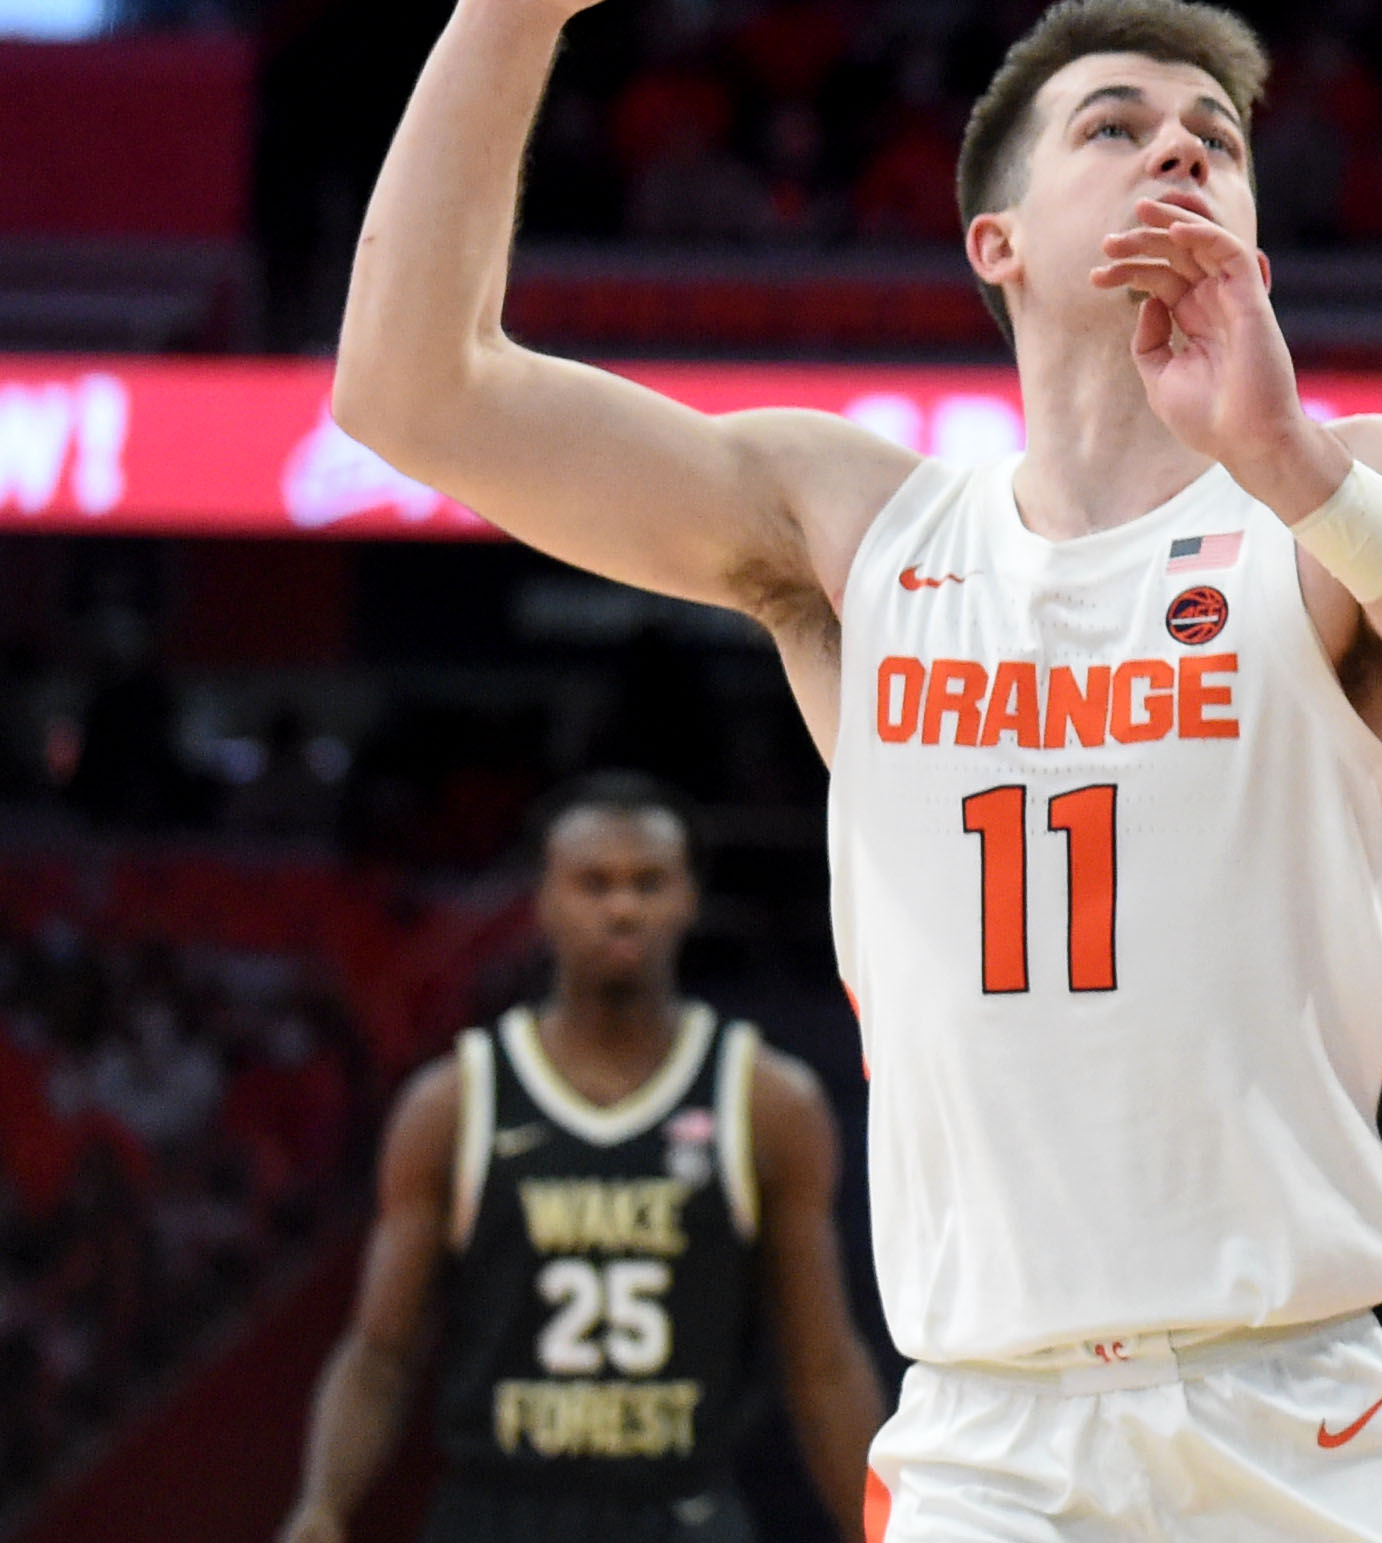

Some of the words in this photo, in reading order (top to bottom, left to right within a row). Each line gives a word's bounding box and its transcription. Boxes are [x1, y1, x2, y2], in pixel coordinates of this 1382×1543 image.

[876, 654, 1241, 748] ORANGE
[961, 784, 1119, 994] 11
[521, 1180, 690, 1255] WAKE
[536, 1260, 674, 1374] 25
[494, 1379, 702, 1457] FOREST
